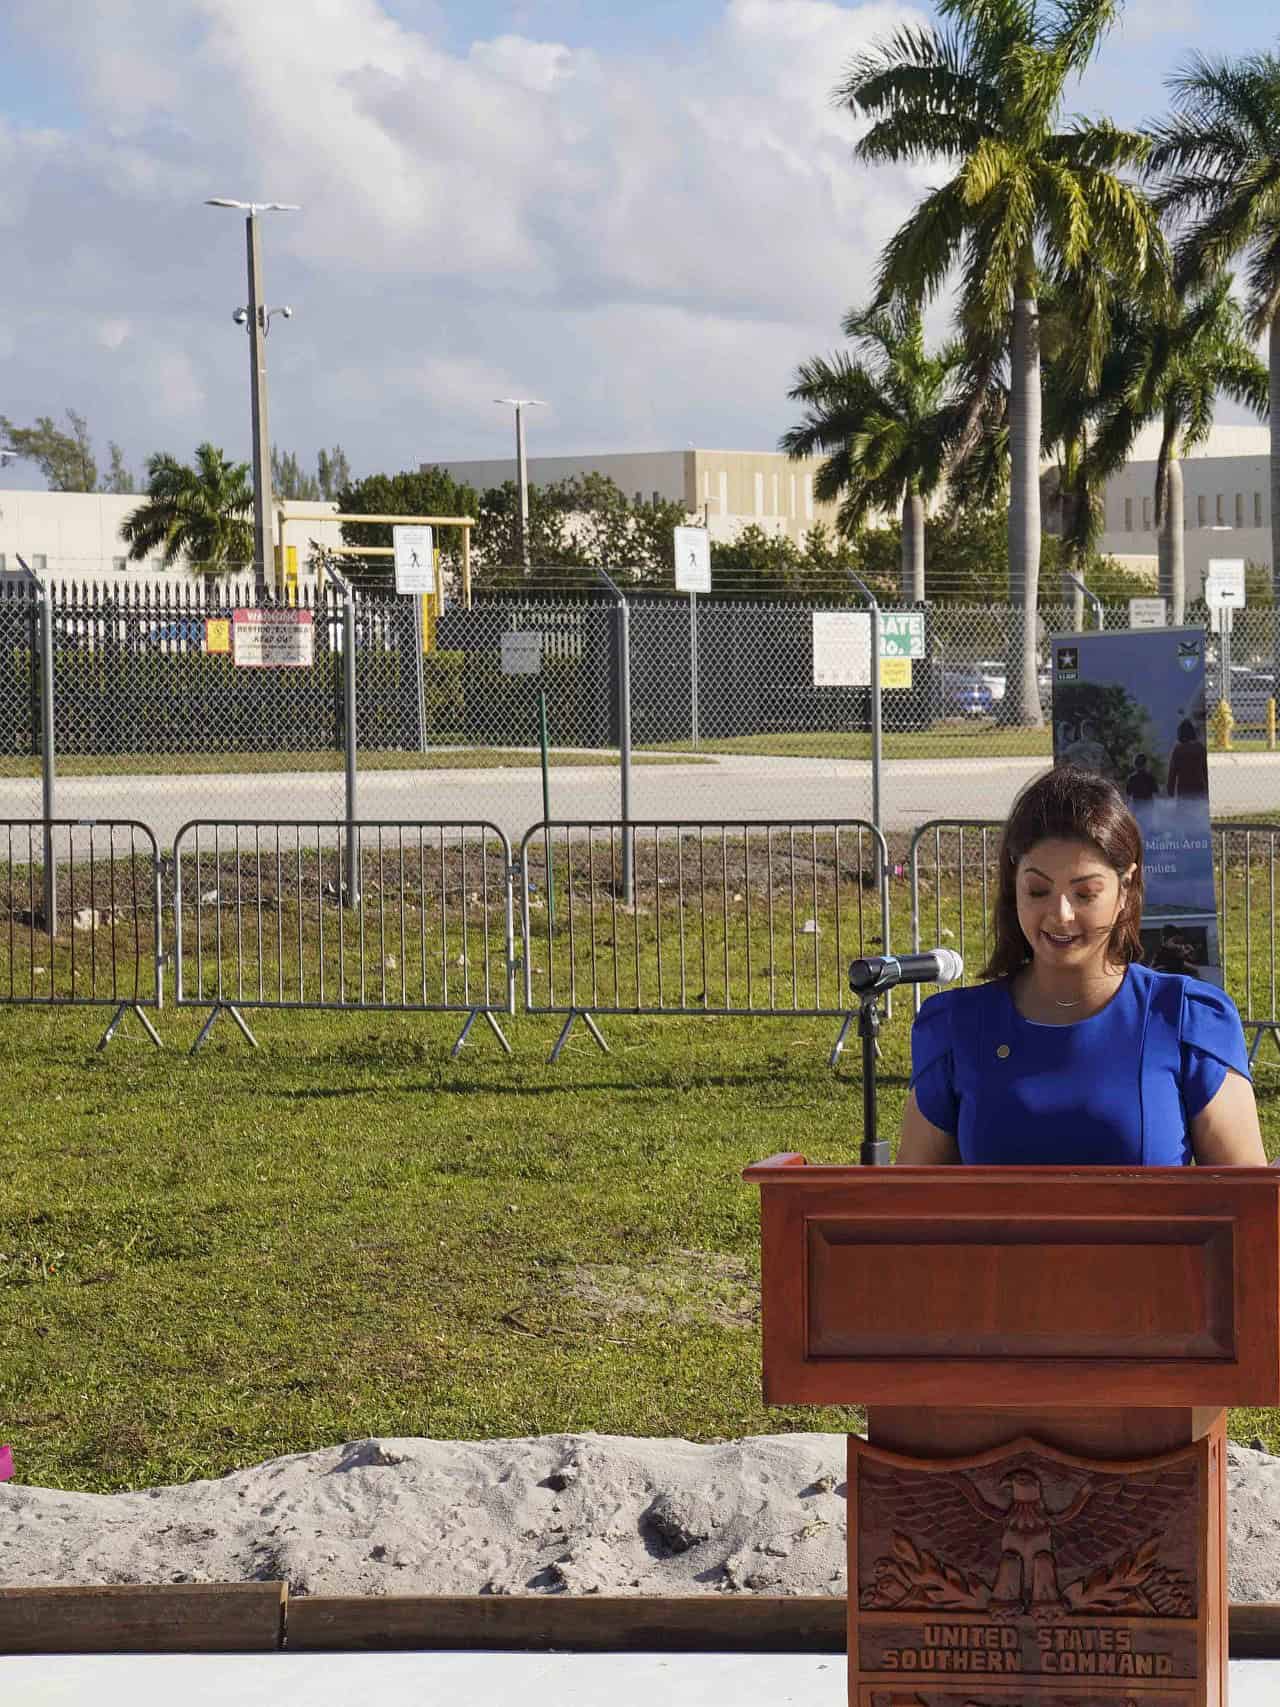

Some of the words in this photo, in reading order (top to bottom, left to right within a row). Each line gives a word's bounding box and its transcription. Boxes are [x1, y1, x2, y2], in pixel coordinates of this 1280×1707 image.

[910, 637, 922, 655] 2
[1141, 863, 1176, 873] milies
[923, 1625, 1020, 1650] UNITED
[1035, 1625, 1133, 1651] STATES
[881, 1648, 1023, 1674] SOUTHERN
[1040, 1652, 1172, 1676] COMMAND
